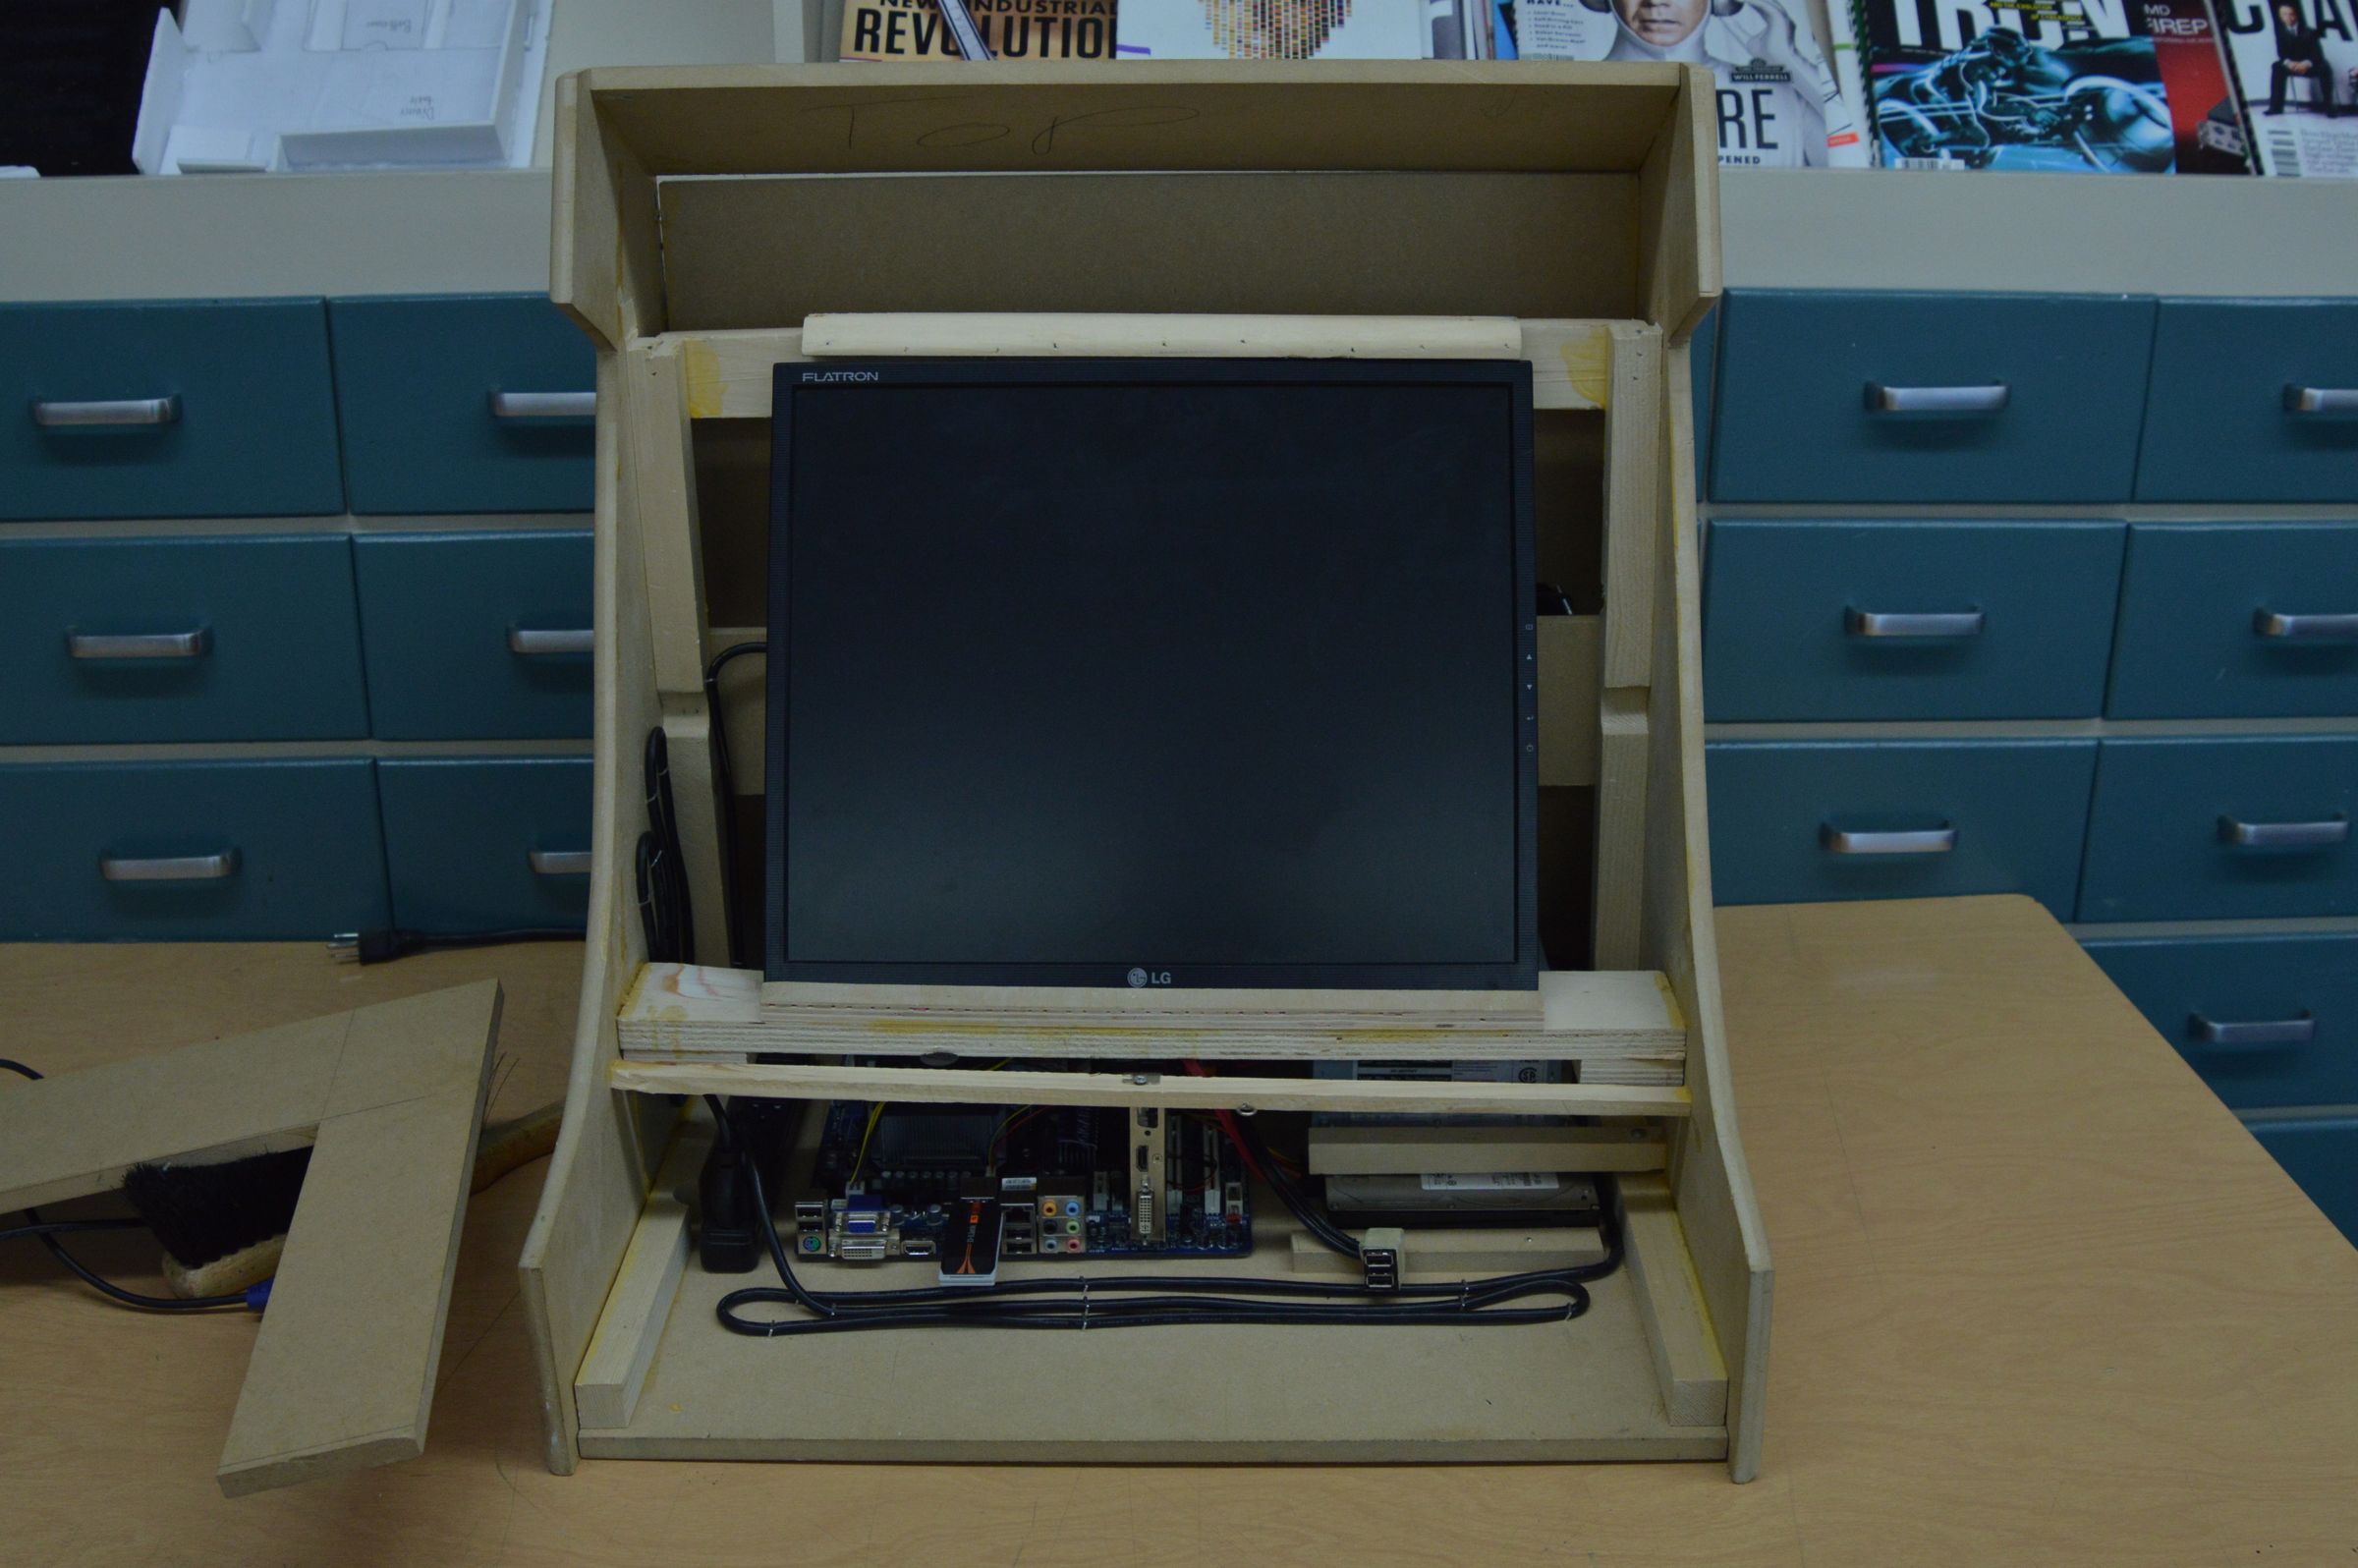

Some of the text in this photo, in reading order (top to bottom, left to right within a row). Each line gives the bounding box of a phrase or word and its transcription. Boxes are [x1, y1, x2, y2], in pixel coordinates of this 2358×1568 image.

[854, 8, 1117, 60] REVOLUTIO
[801, 370, 880, 383] FLATRON
[1151, 971, 1172, 984] LG
